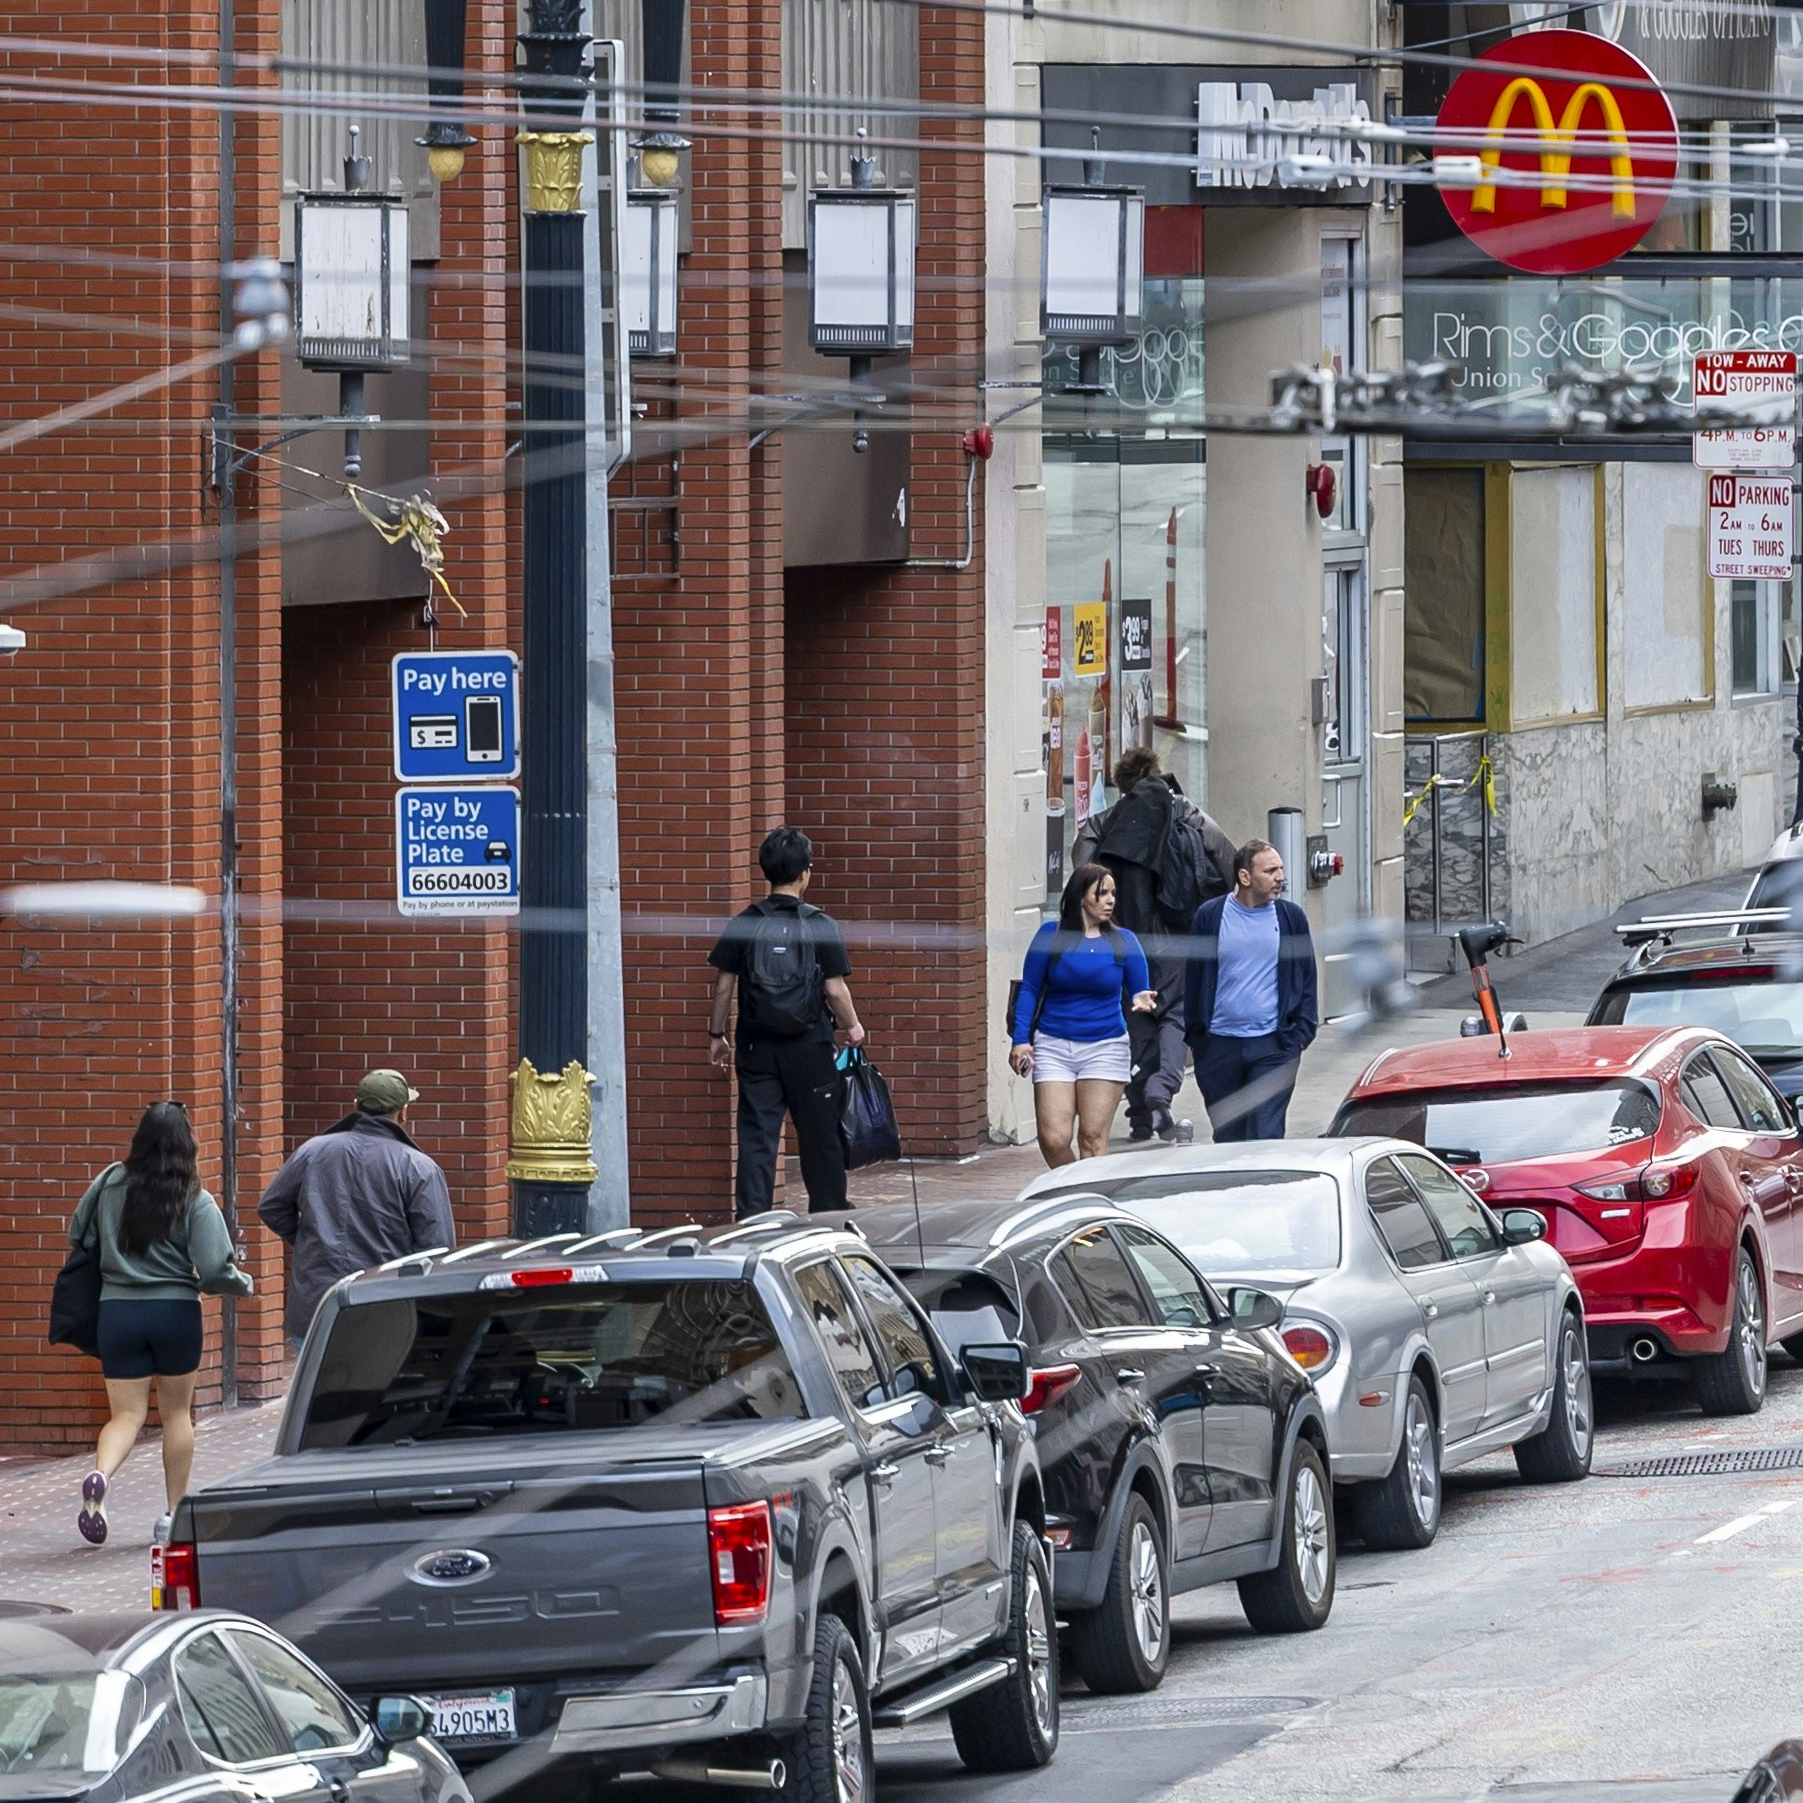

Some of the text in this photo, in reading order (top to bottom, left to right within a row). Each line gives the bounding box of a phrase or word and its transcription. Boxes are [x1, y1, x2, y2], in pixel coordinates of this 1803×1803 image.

[1697, 369, 1794, 393] NO STOPPING
[1711, 479, 1789, 507] NO PARKING
[1718, 538, 1785, 557] TUES THURS
[1715, 563, 1787, 577] STREET SWEEPING
[403, 666, 507, 695] Pay here
[408, 796, 482, 823] Pay by
[408, 820, 489, 841] License
[408, 842, 464, 864] Plate
[412, 872, 508, 891] 66604003
[403, 901, 417, 910] Pay
[418, 901, 428, 909] by
[430, 900, 455, 909] phone
[467, 900, 475, 908] at
[477, 900, 518, 910] paystation
